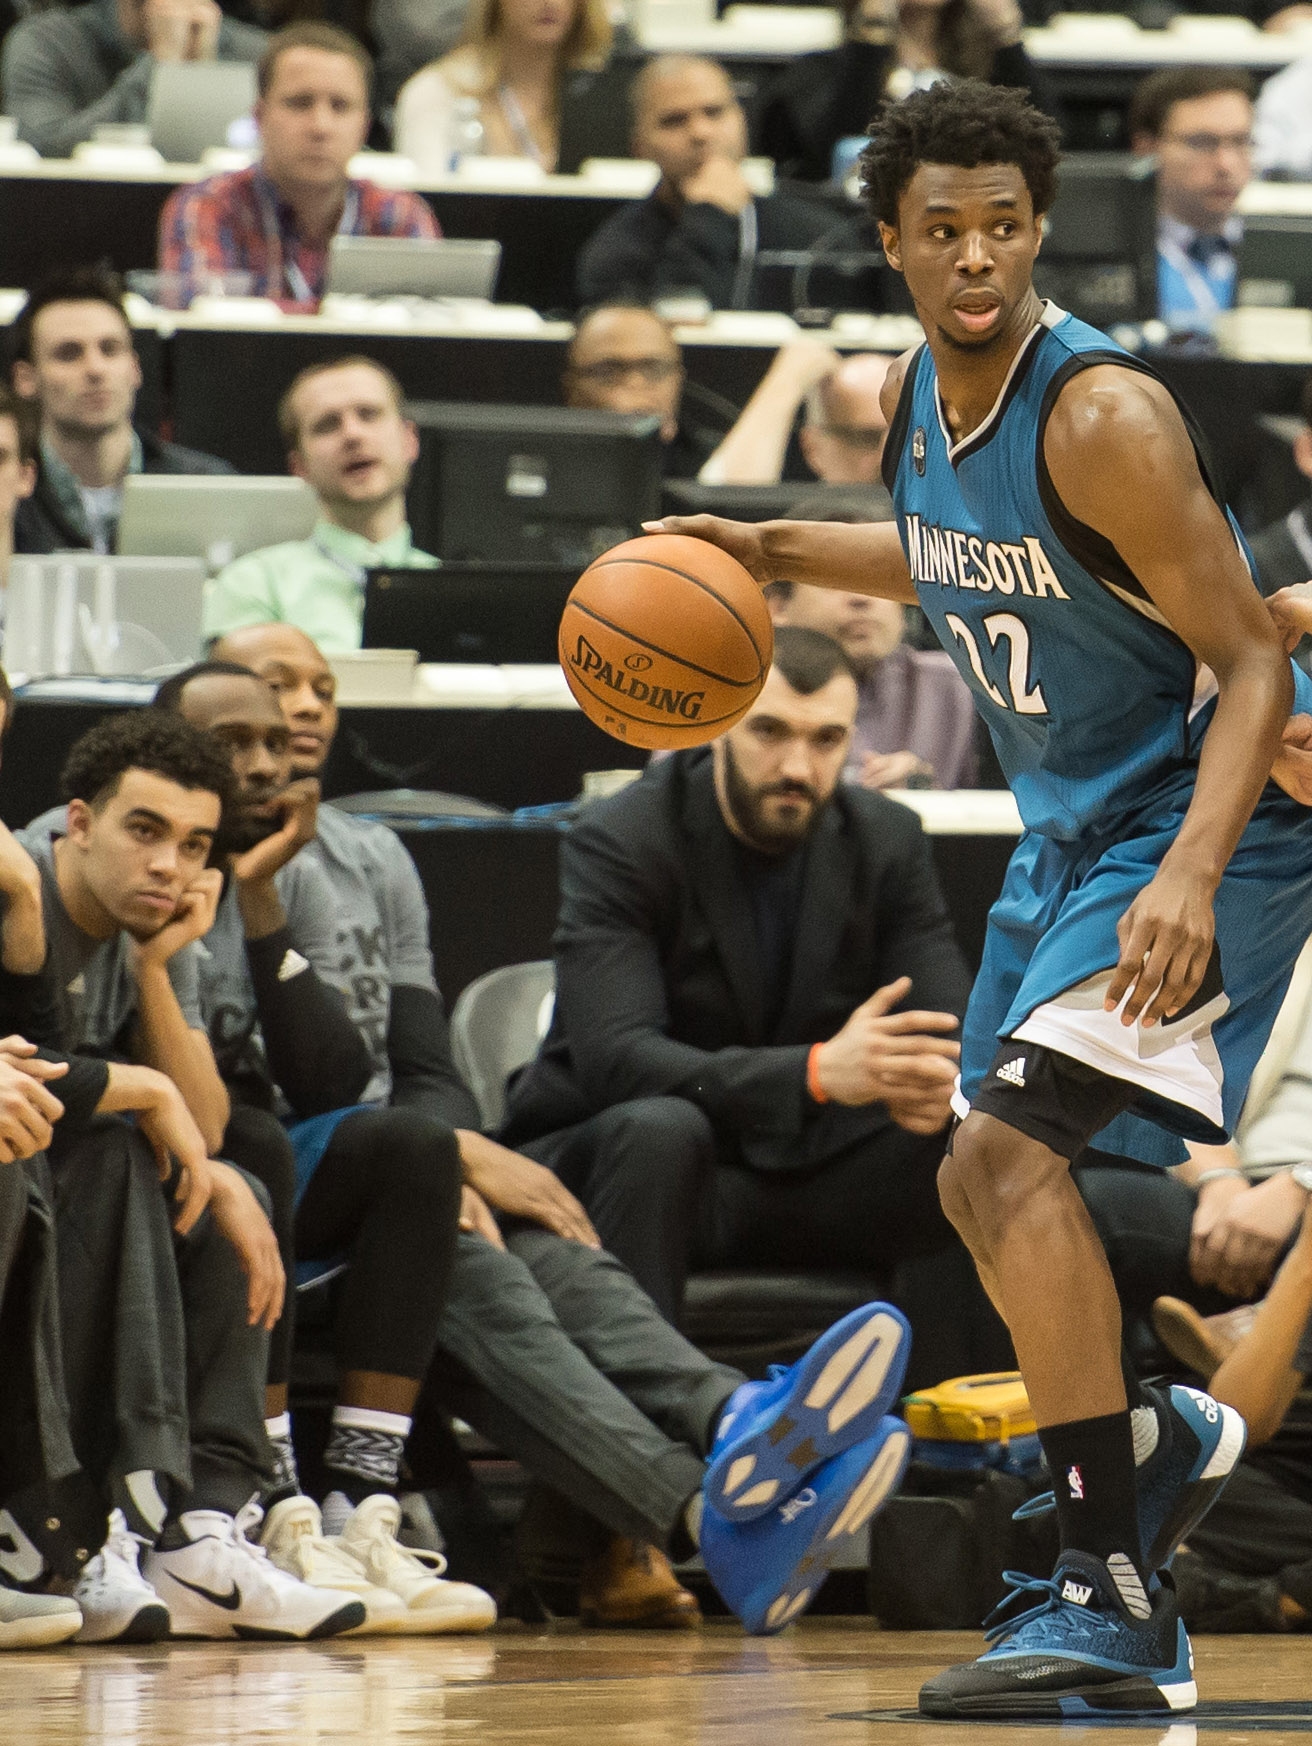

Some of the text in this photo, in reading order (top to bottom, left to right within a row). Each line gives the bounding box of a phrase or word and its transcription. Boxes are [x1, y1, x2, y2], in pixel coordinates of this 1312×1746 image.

[905, 514, 1072, 600] MINNESOTA
[571, 634, 706, 720] SPALDING
[945, 612, 1049, 715] 22
